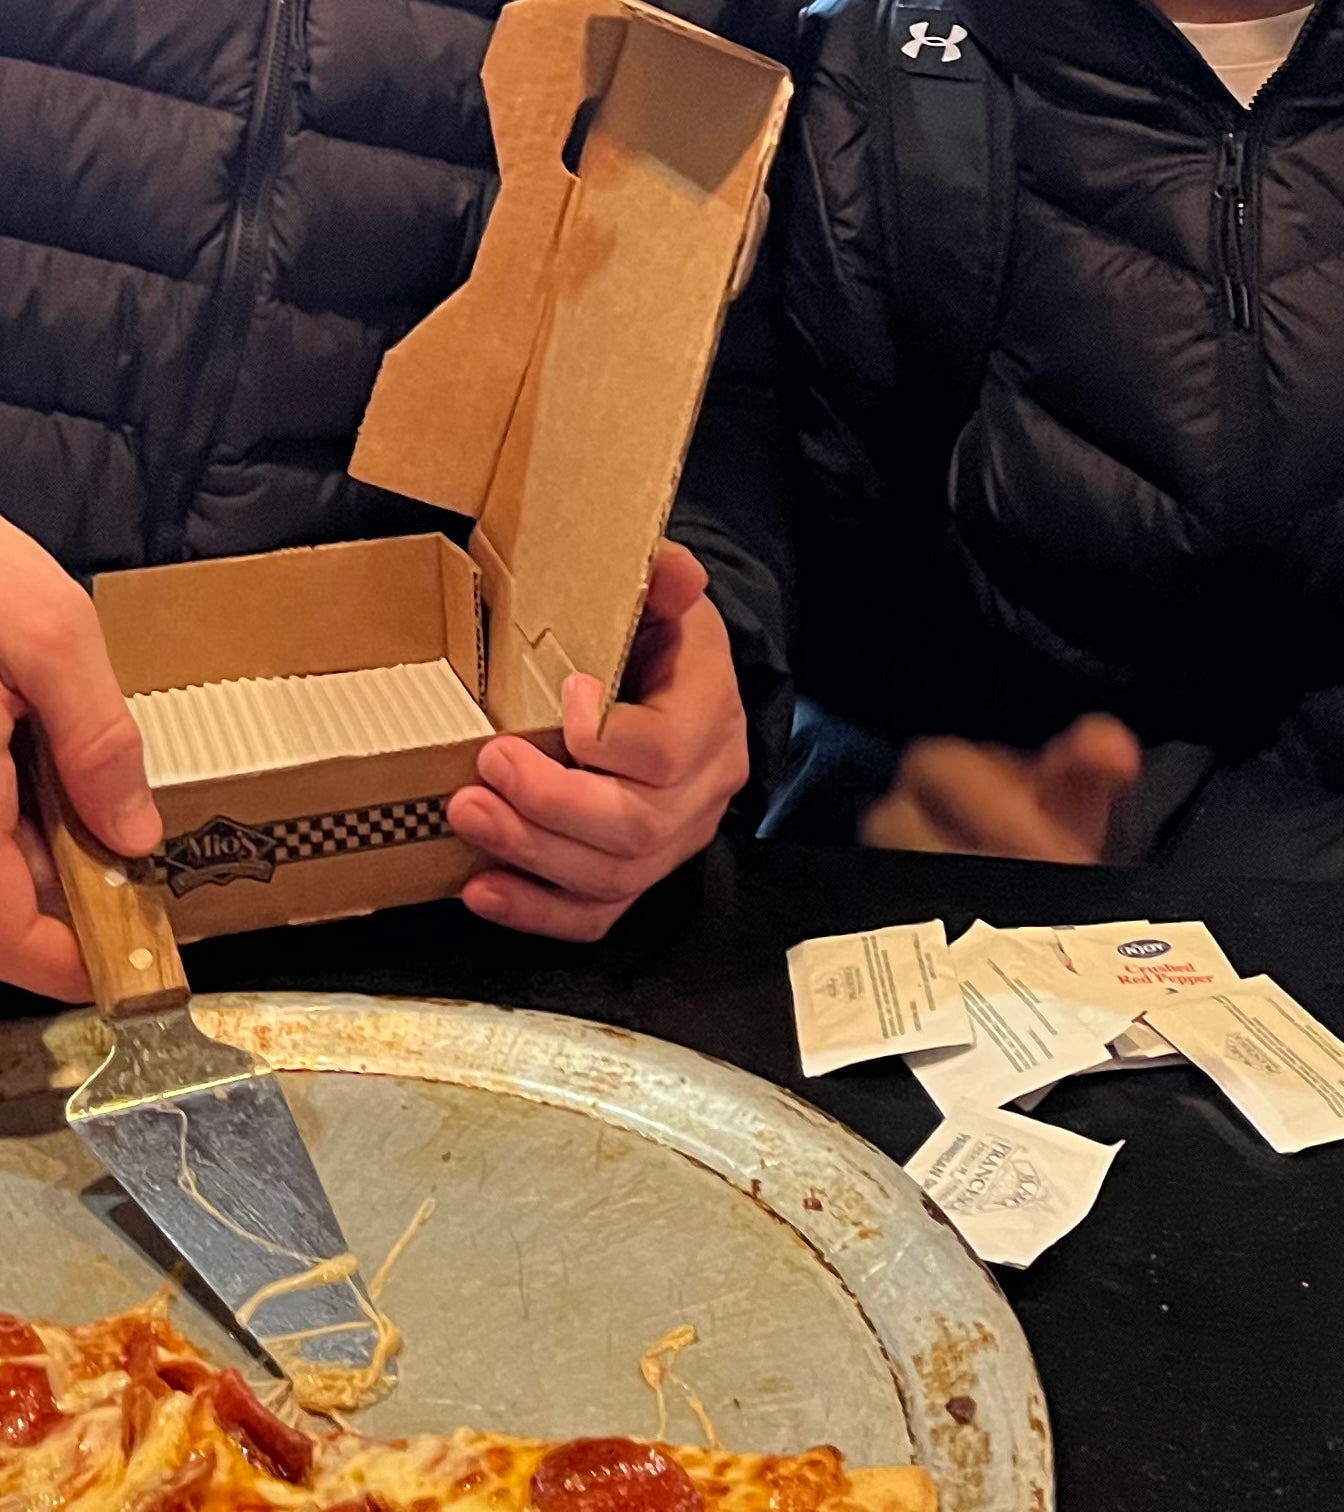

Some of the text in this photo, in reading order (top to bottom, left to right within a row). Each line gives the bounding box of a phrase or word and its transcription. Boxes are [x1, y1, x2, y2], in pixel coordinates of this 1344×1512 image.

[1124, 962, 1197, 974] Crushed
[1116, 973, 1214, 986] Red Pepper
